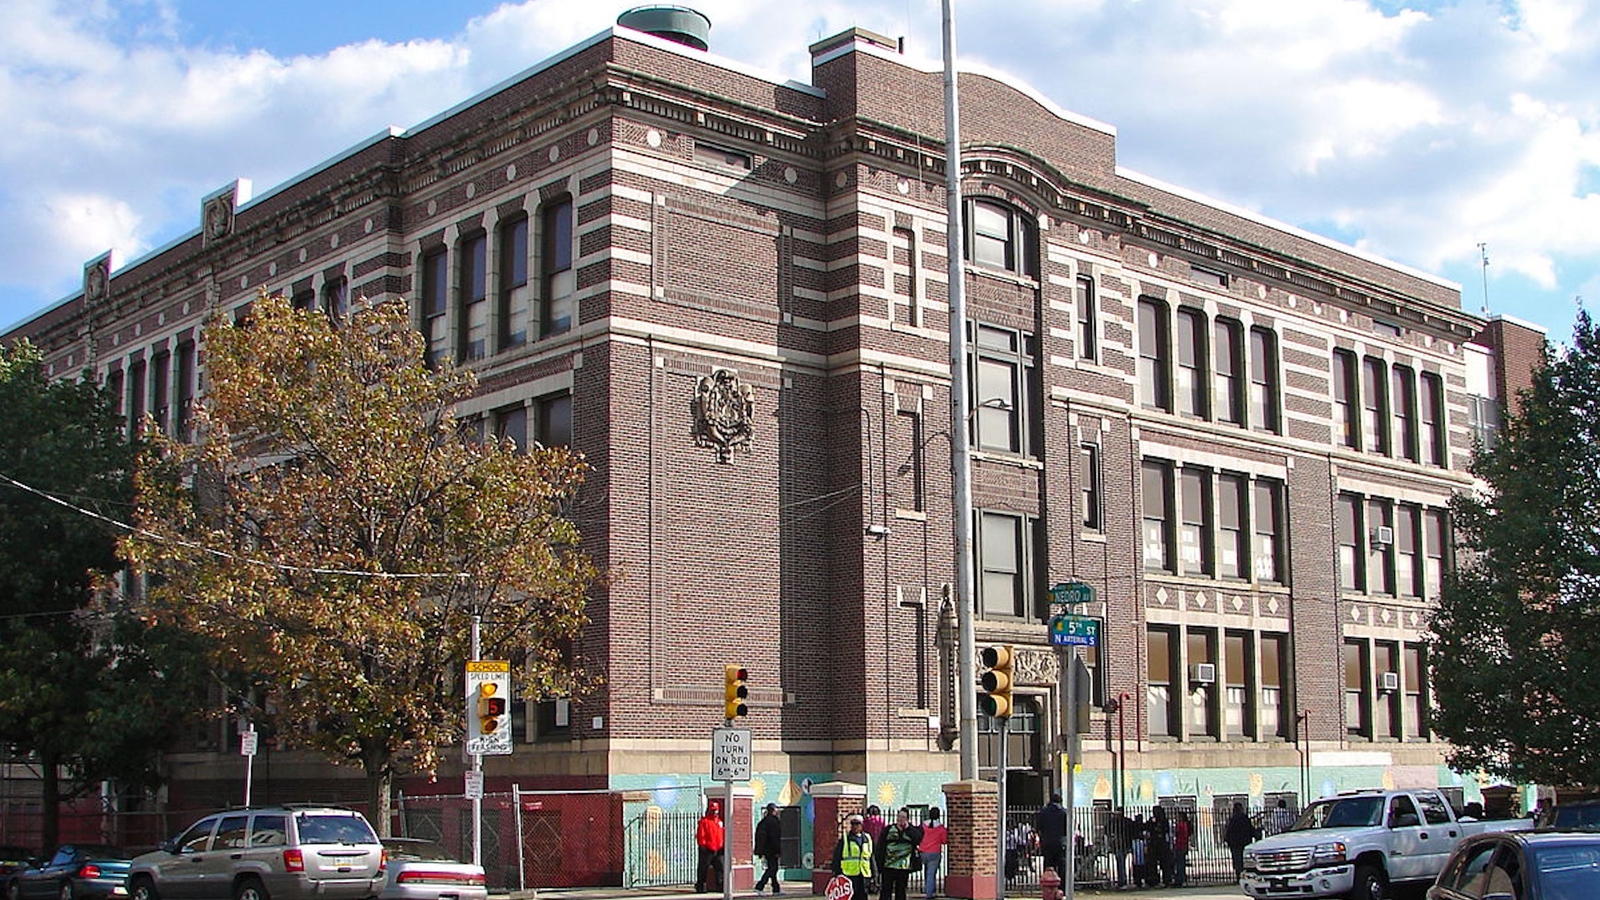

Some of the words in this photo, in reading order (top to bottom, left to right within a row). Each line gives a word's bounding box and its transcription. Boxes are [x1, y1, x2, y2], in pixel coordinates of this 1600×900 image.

[1086, 626, 1096, 636] ST
[1054, 633, 1061, 644] N
[1088, 636, 1095, 645] S
[472, 662, 503, 672] SCHOOL
[470, 672, 490, 680] SPEED
[490, 672, 507, 681] LIMIT
[725, 734, 739, 742] NO
[721, 745, 743, 753] TURN
[715, 756, 728, 764] ON
[731, 756, 748, 764] RED
